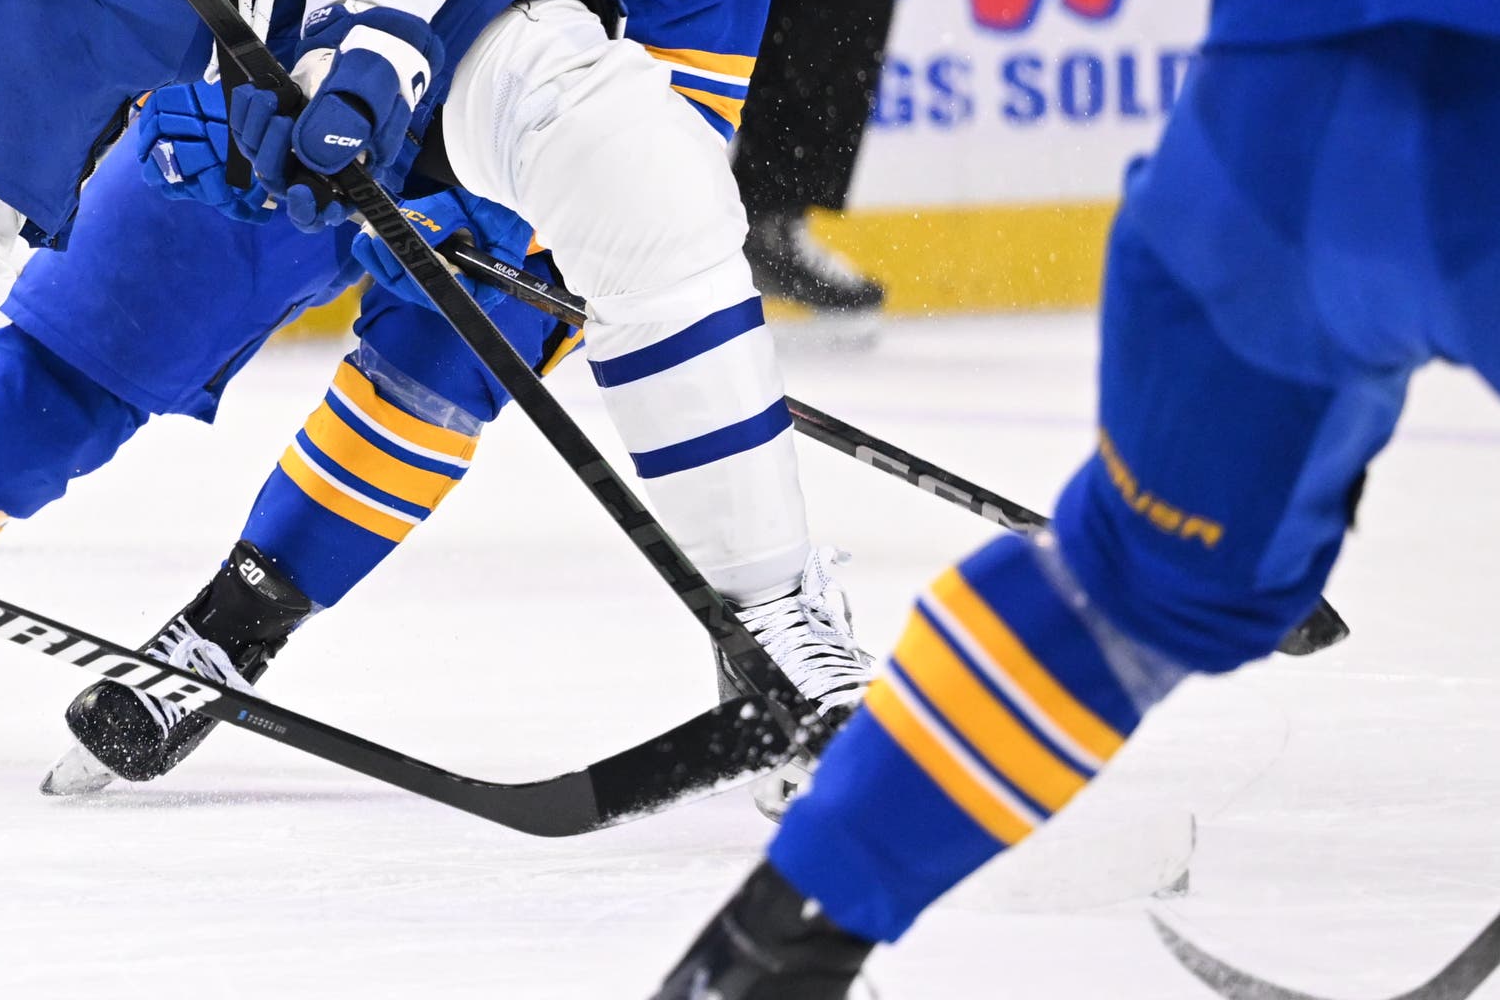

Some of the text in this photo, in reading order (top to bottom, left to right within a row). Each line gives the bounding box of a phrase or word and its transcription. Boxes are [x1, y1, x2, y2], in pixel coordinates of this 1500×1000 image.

[323, 133, 363, 148] CCM
[493, 261, 520, 280] KULICH
[238, 557, 267, 587] 20
